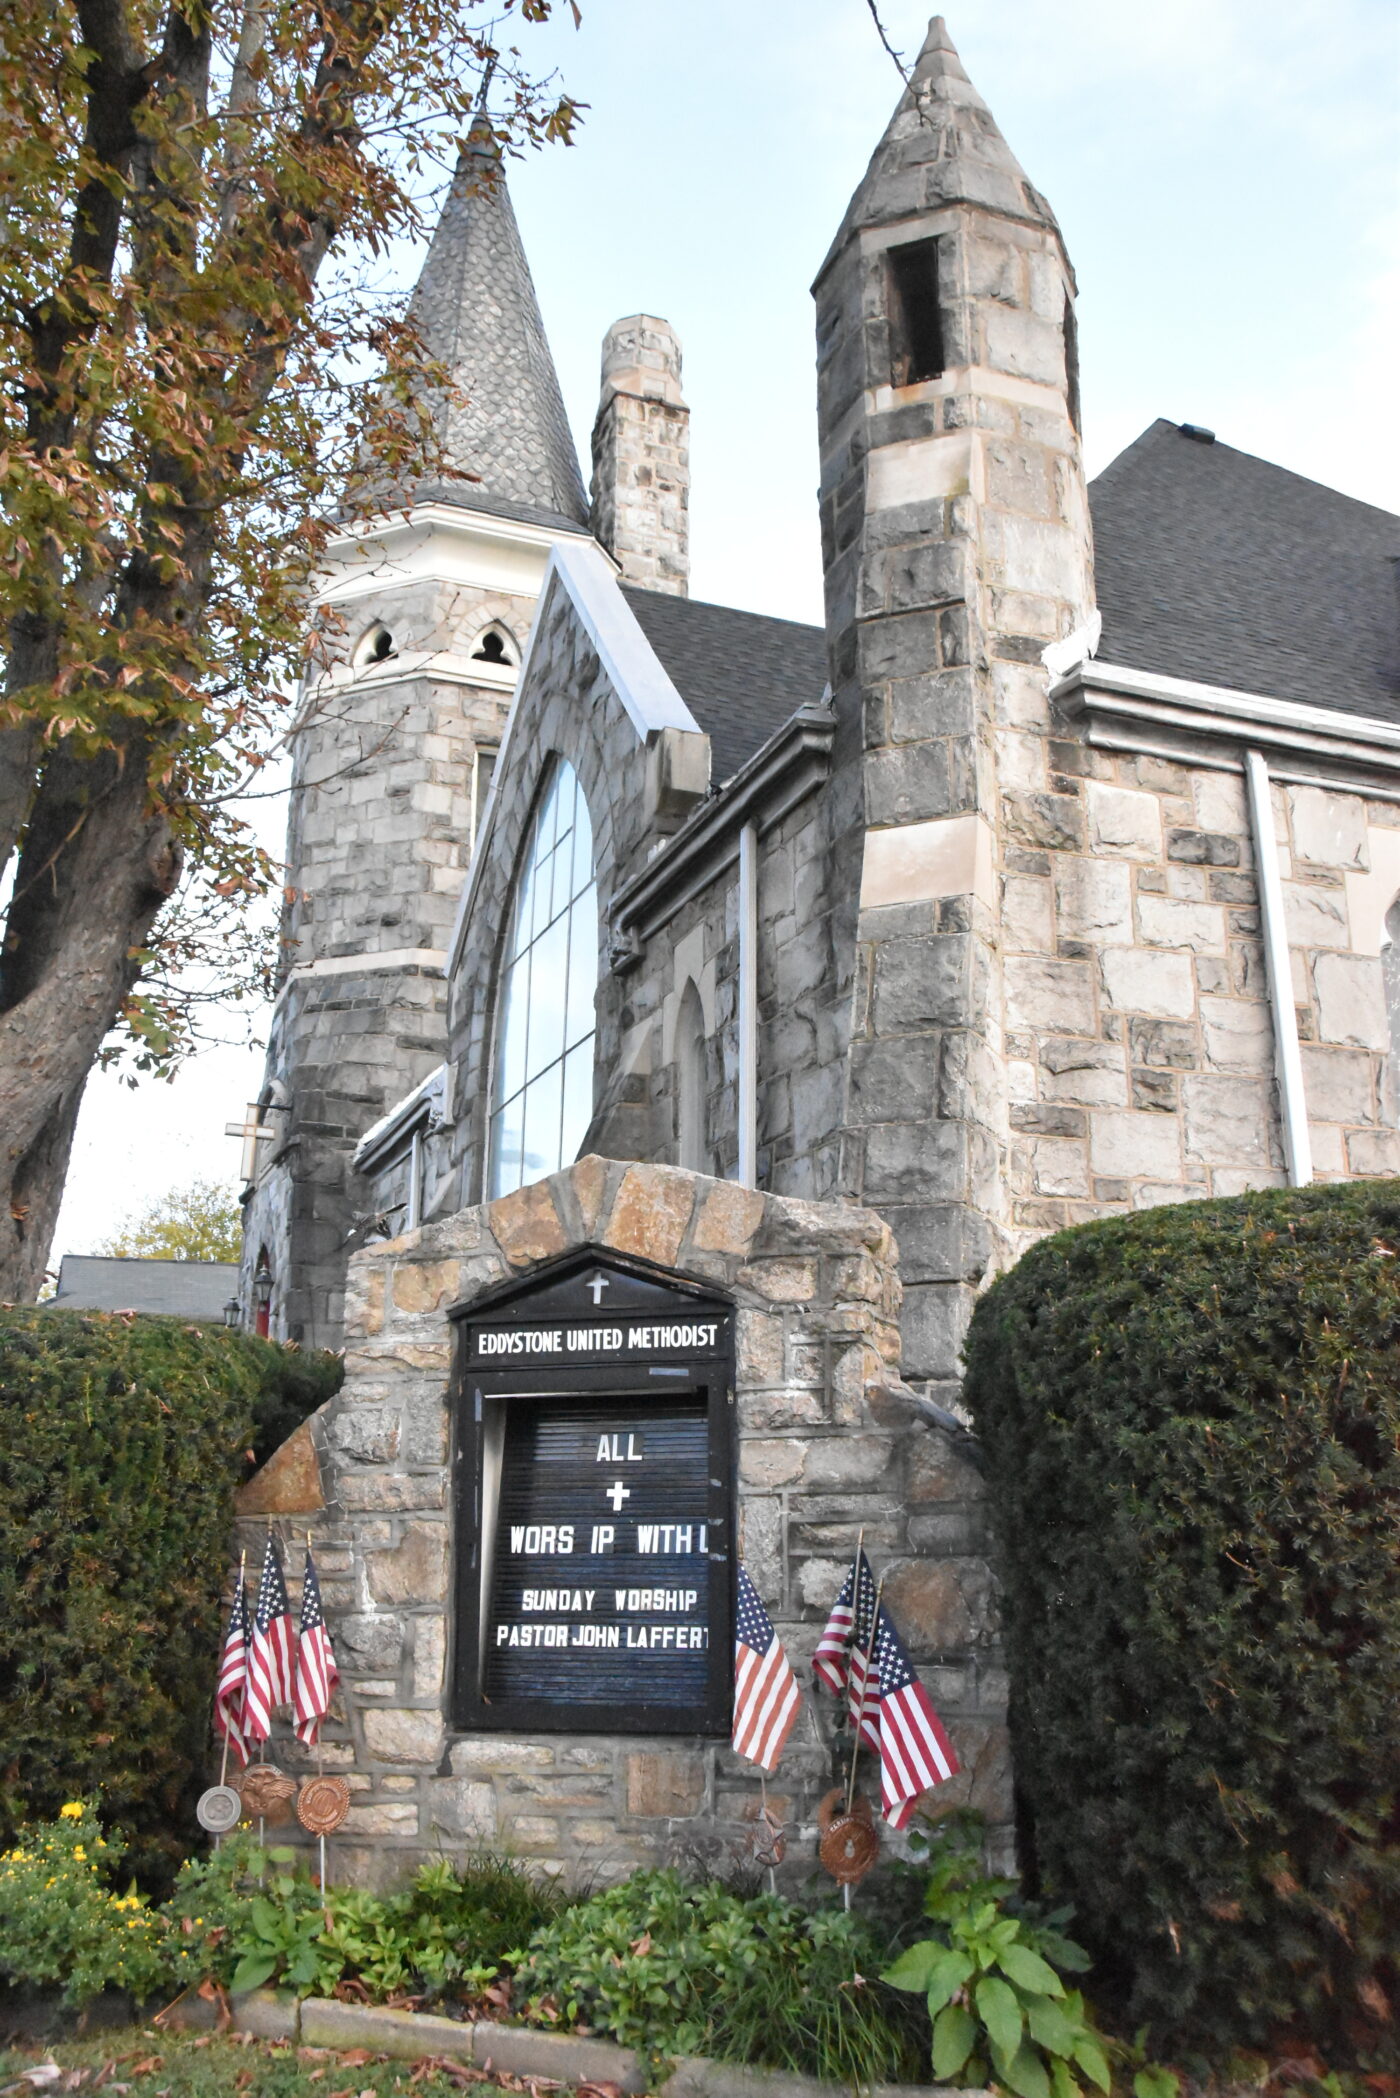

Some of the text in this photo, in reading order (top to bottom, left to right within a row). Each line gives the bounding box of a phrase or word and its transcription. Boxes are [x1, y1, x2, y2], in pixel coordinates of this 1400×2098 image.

[478, 1324, 718, 1355] EDDYSTONE UNITED METHODIST
[596, 1433, 643, 1462] ALL
[637, 1524, 692, 1554] WITH
[521, 1588, 698, 1612] SUNDAY WORSHIP
[496, 1624, 569, 1647] PASTOR
[571, 1624, 620, 1648] JOHN
